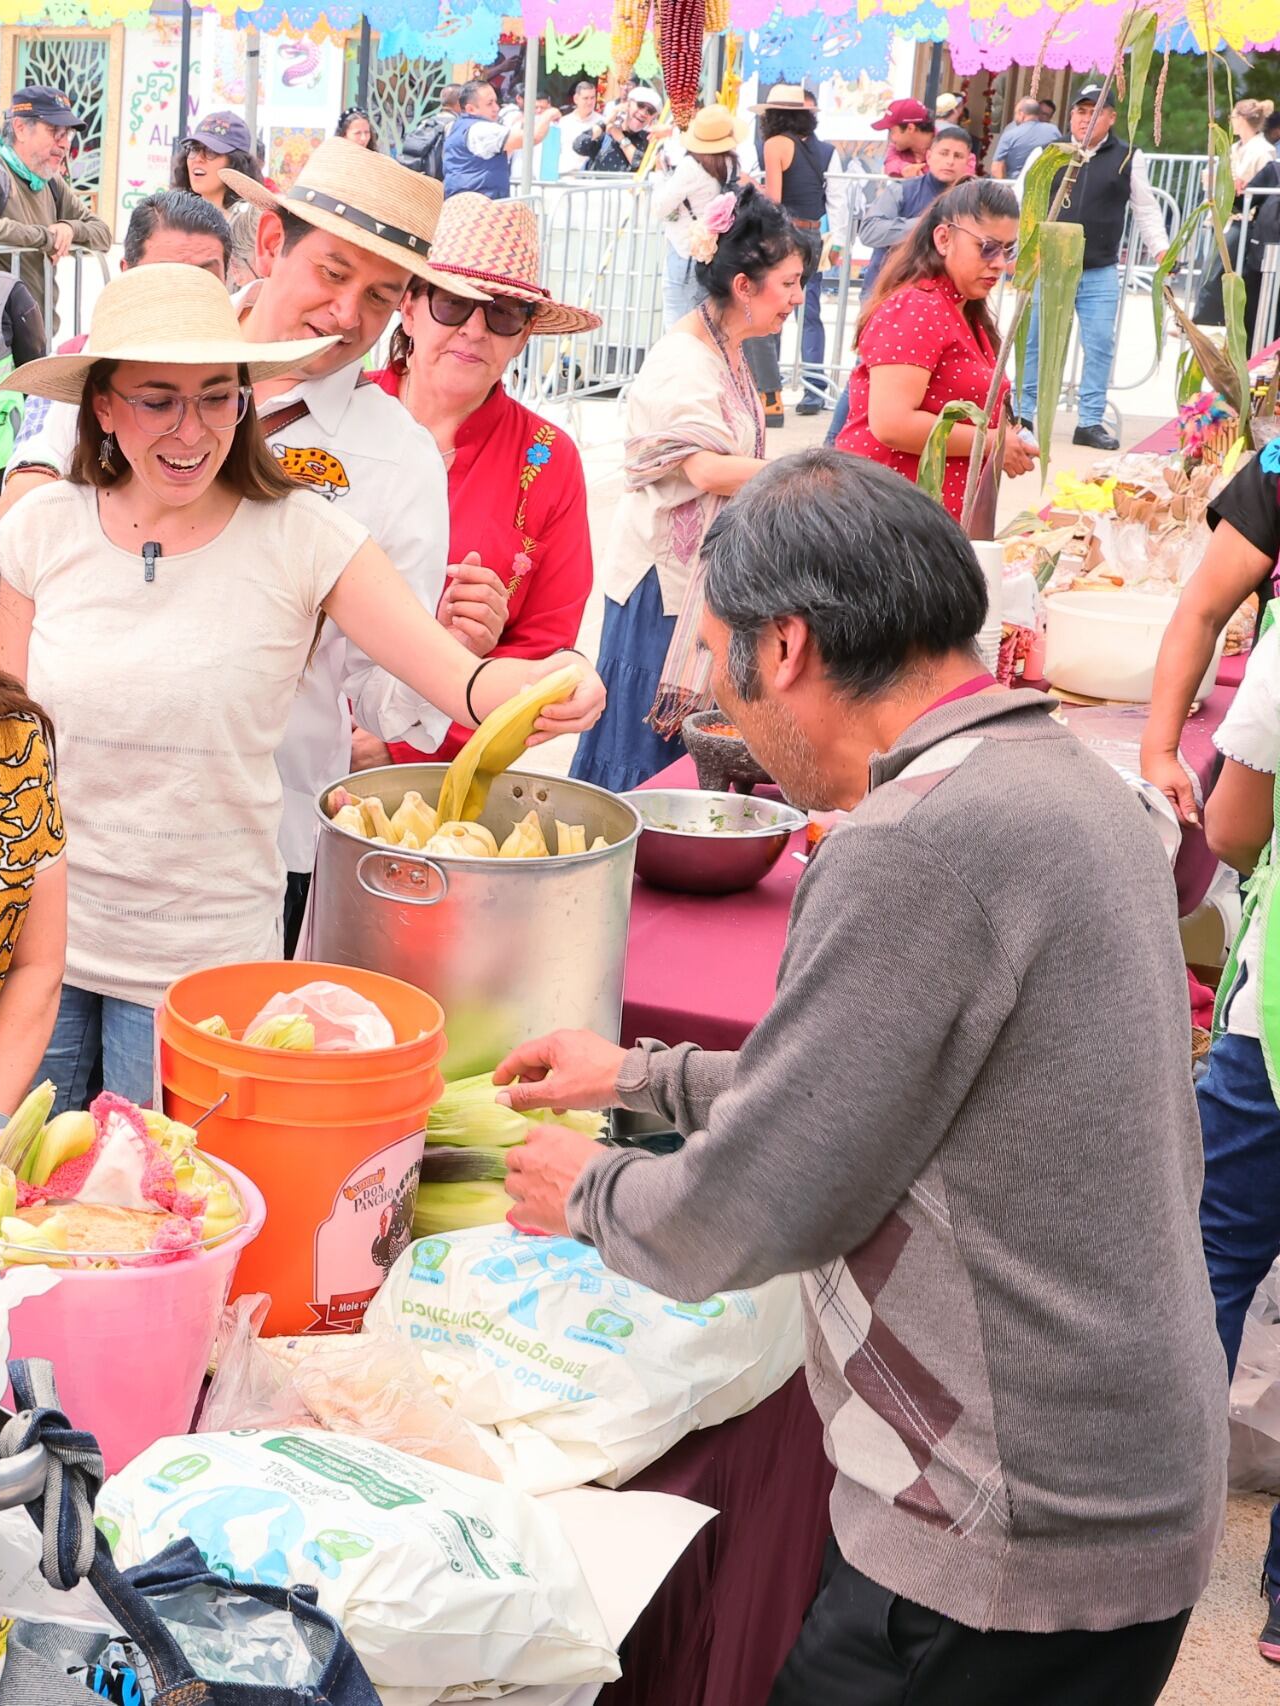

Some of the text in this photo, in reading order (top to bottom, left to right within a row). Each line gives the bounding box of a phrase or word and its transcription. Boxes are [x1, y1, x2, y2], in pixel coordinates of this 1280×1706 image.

[149, 123, 173, 146] AL
[354, 1188, 394, 1213] PANCHO
[363, 1183, 385, 1200] DON
[338, 1301, 359, 1313] Mole
[485, 1323, 588, 1380] Emergenci
